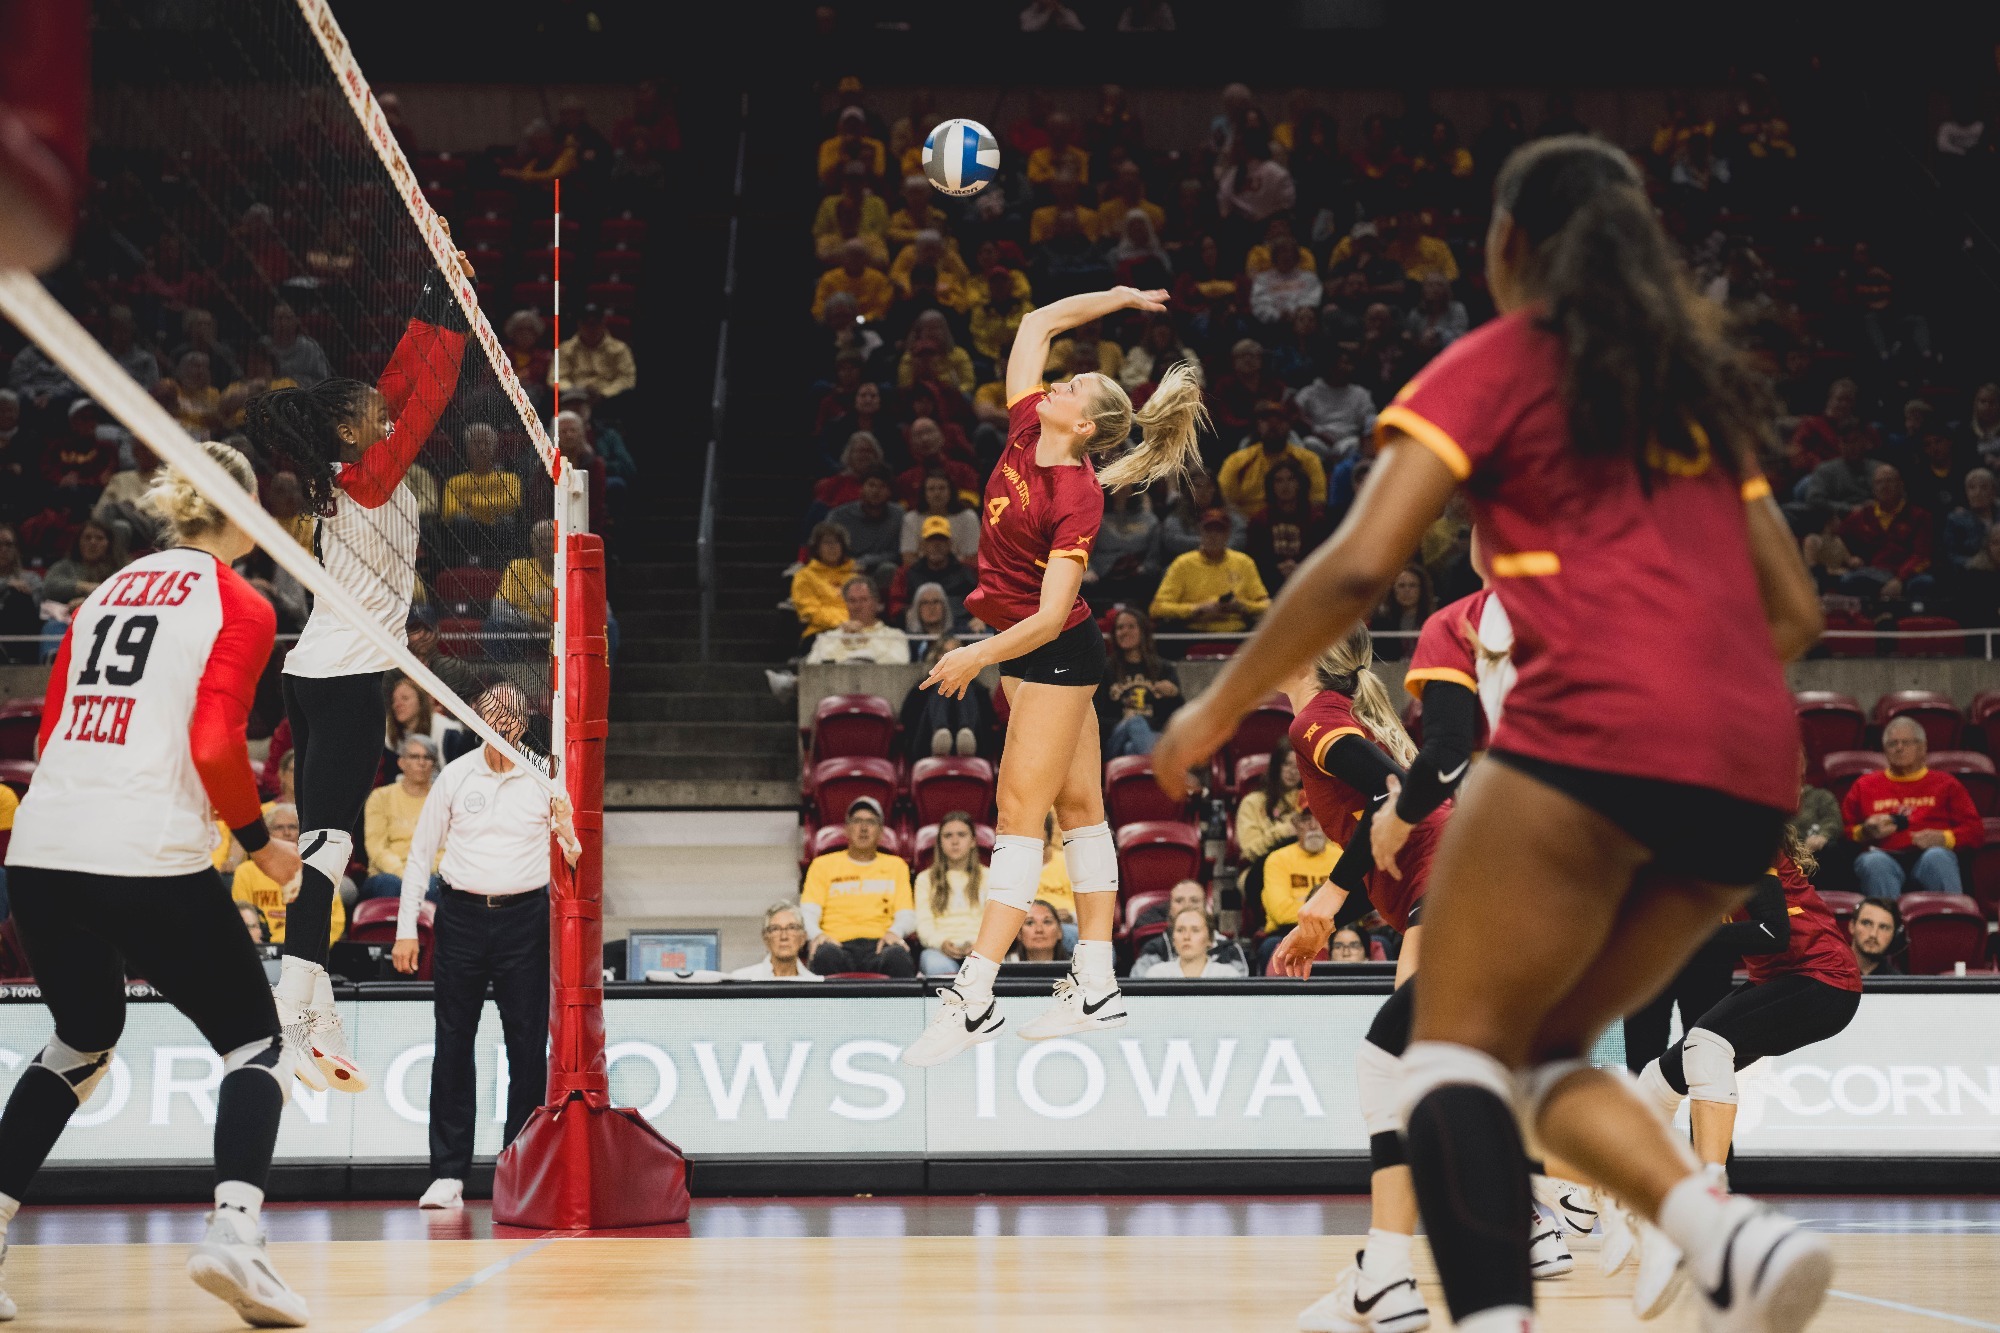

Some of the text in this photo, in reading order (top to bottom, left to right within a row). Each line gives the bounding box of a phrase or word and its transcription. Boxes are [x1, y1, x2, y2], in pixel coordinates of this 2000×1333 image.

[988, 496, 1011, 527] 4
[1015, 480, 1030, 512] STATE
[99, 570, 201, 607] TEXAS
[77, 614, 159, 687] 19
[64, 695, 137, 746] TECH
[975, 1038, 1326, 1119] IOWA
[1781, 1064, 2000, 1116] CORN
